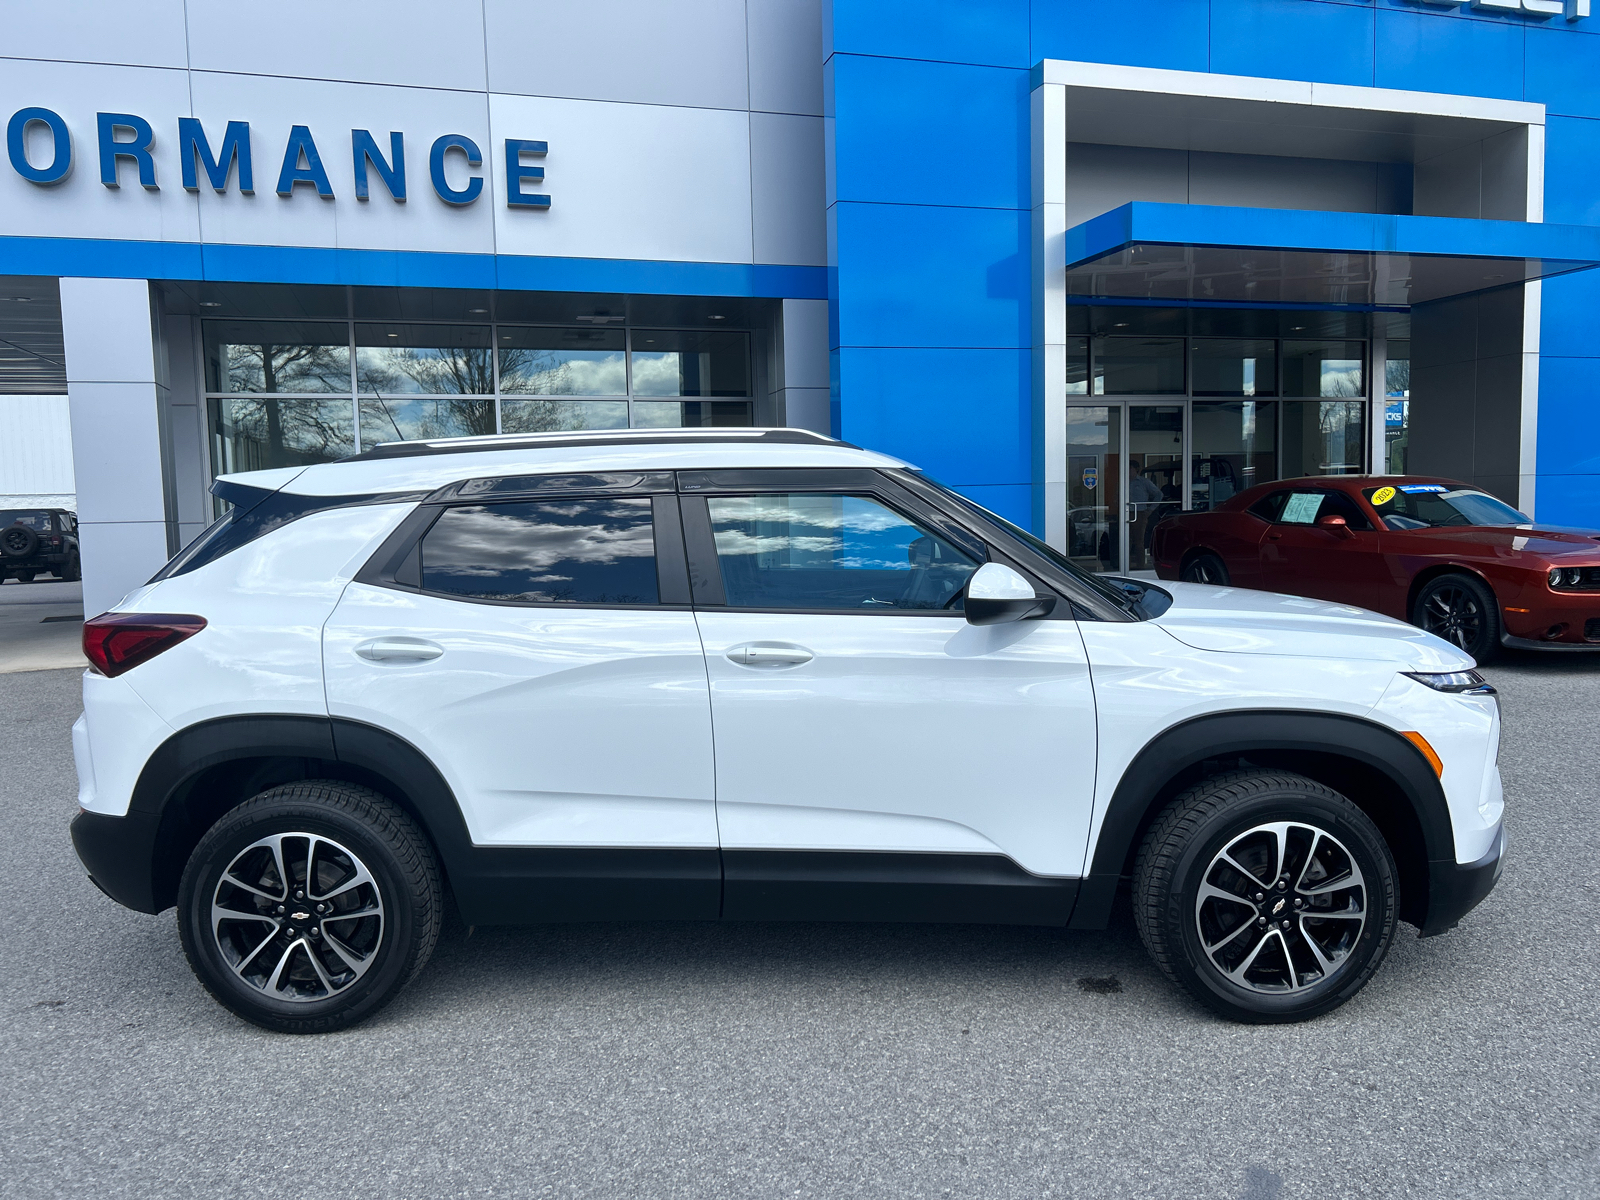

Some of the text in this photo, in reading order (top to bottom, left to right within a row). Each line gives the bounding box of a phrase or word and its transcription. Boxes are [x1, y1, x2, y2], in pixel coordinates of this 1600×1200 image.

[6, 106, 552, 210] ORMANCE
[1385, 412, 1402, 421] CKS
[1375, 488, 1393, 503] 2023
[1378, 871, 1393, 949] TOURING
